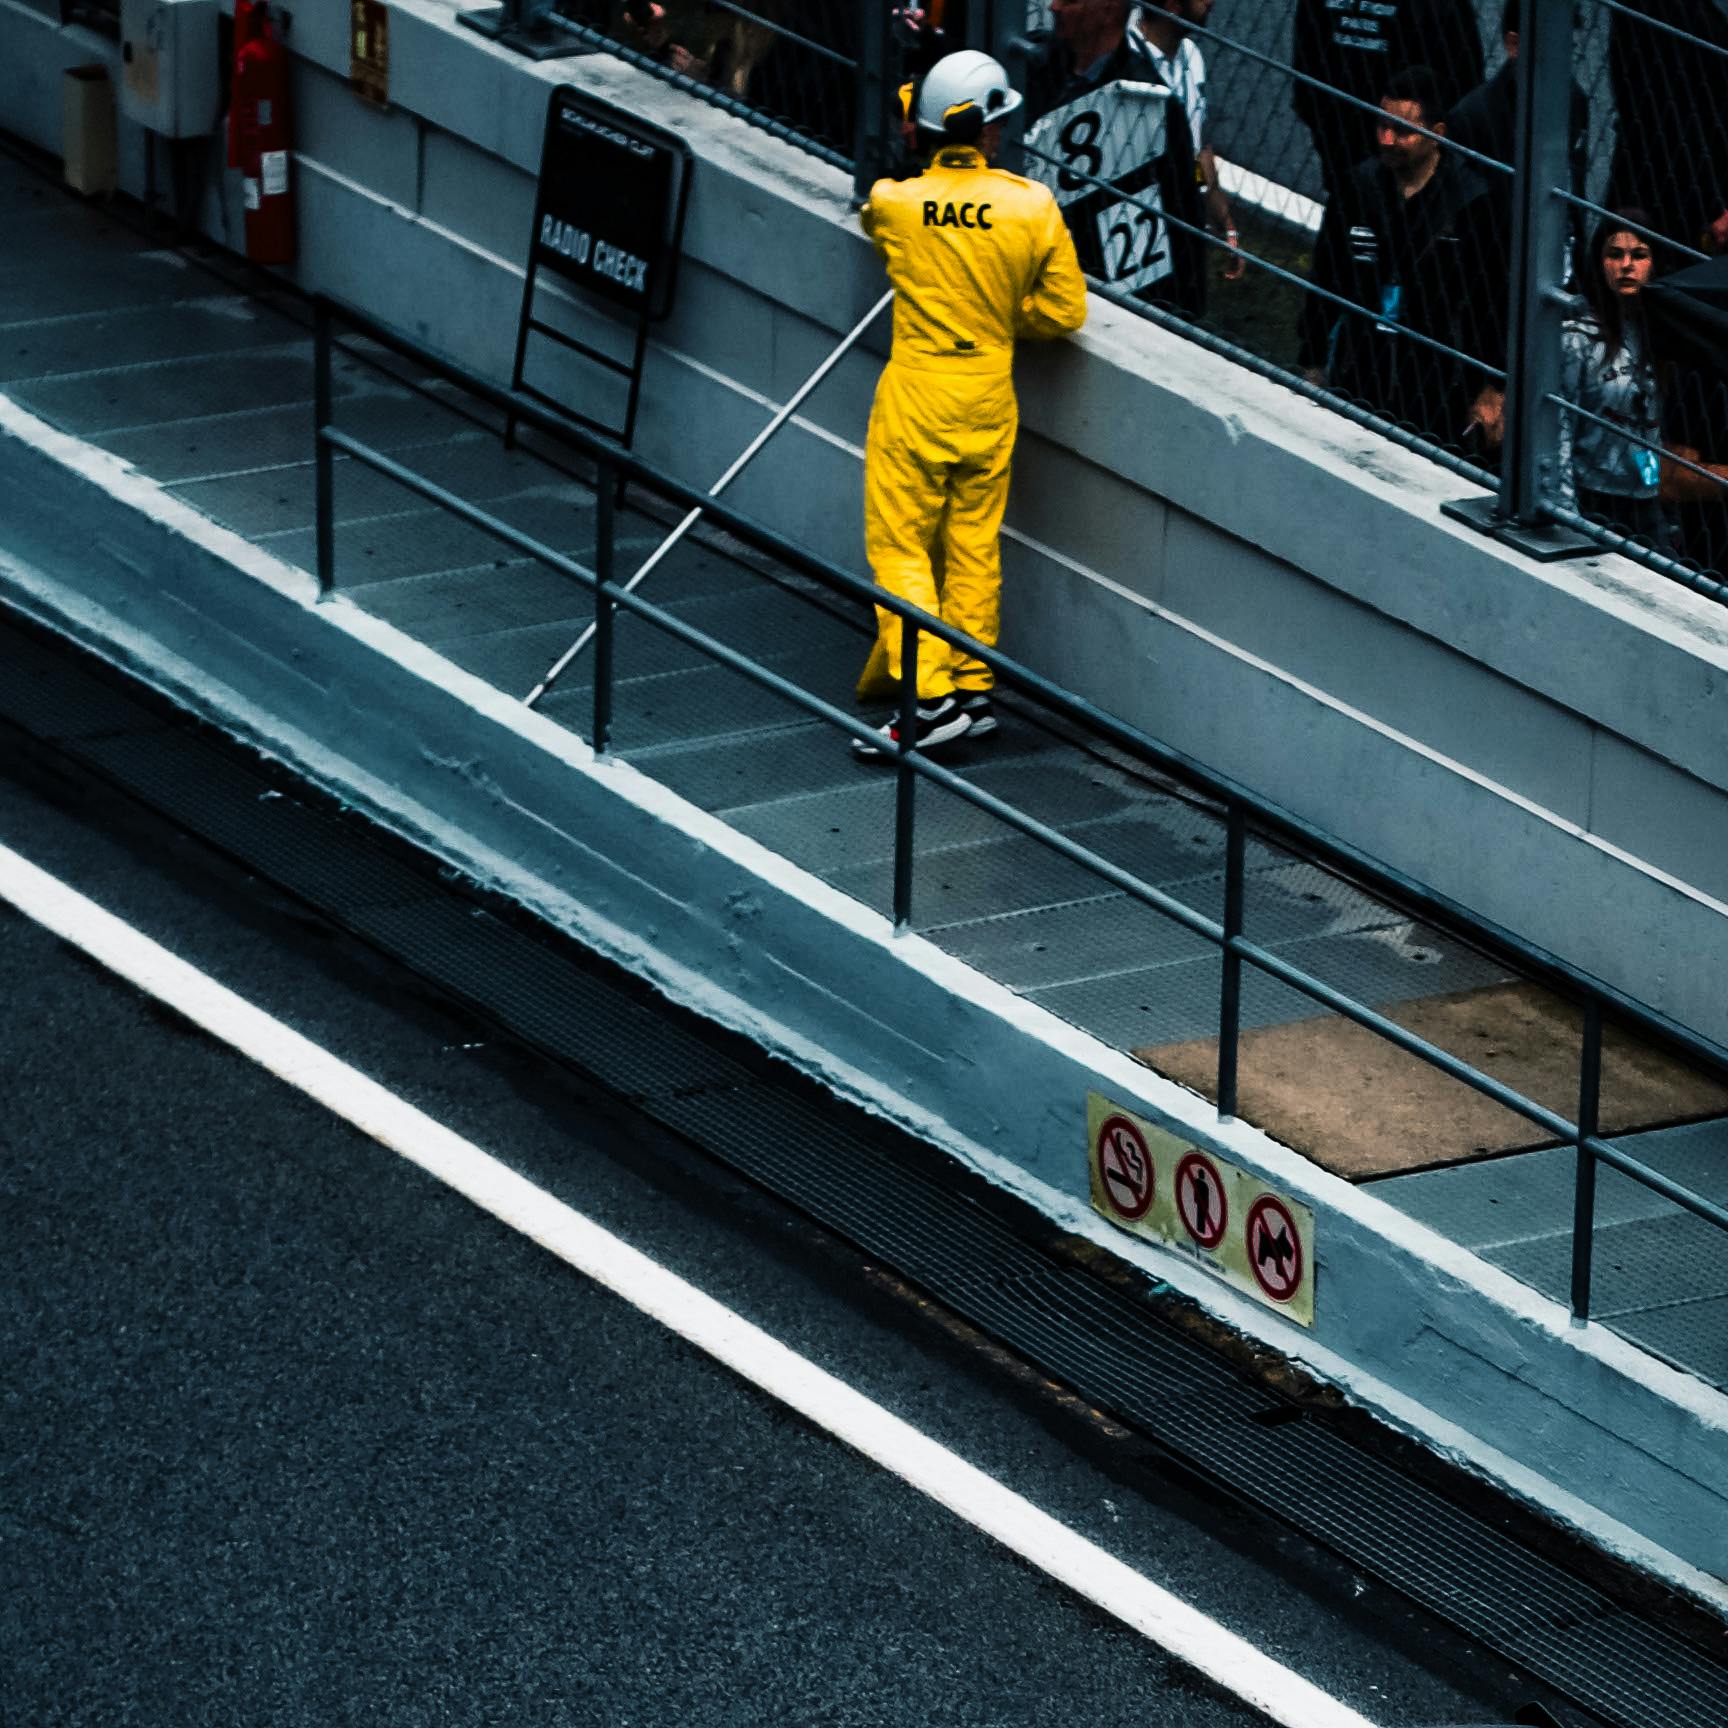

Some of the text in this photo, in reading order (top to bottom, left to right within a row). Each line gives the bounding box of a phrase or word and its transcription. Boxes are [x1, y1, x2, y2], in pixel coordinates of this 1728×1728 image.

[1058, 110, 1102, 191] 8
[540, 213, 649, 292] RADIO CHECK
[923, 200, 993, 230] RACC
[1105, 208, 1166, 281] 22
